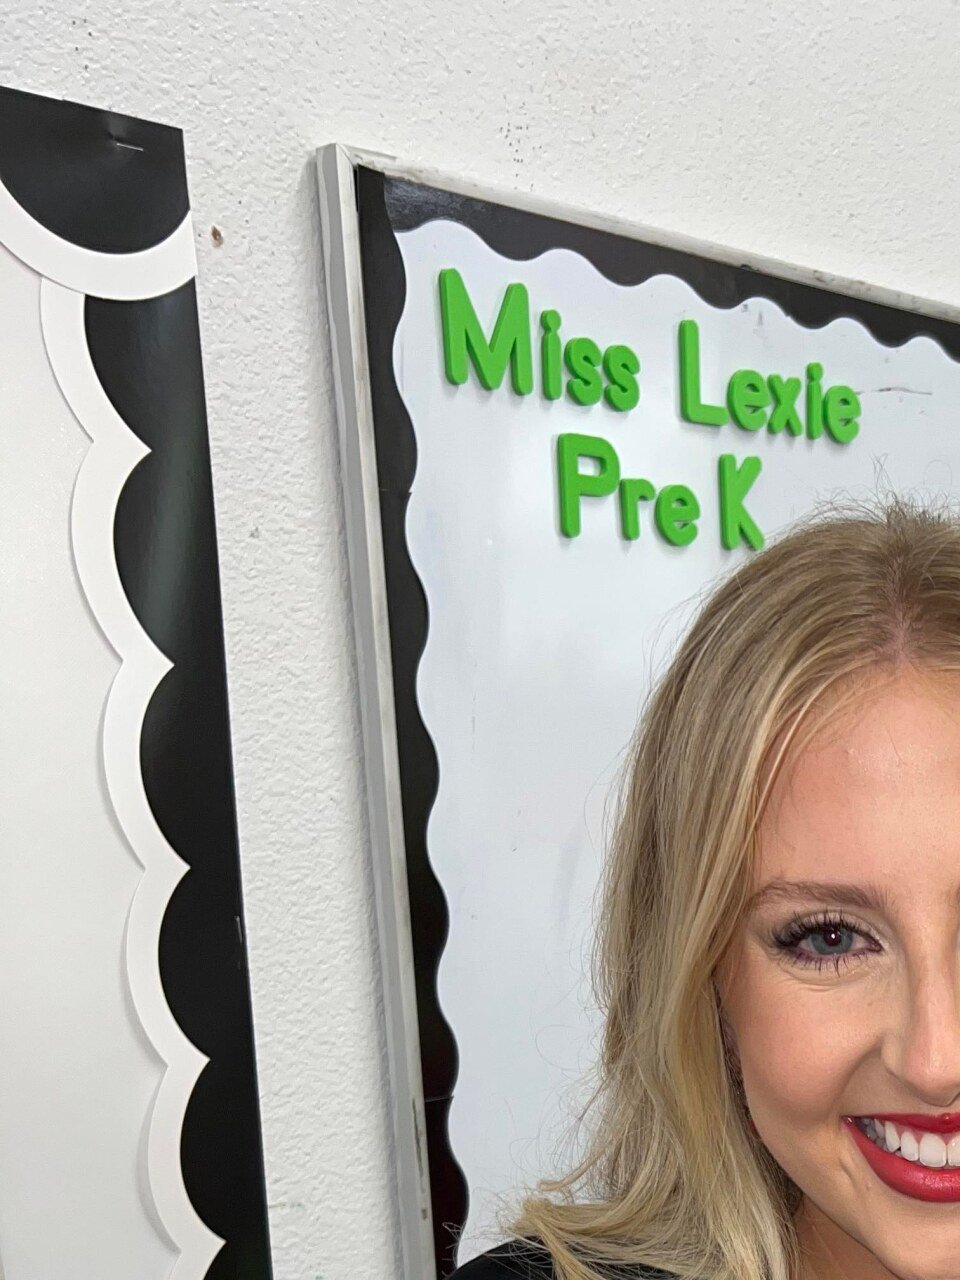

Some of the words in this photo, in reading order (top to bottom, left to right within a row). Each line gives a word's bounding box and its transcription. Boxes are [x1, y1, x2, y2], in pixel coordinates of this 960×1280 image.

[439, 268, 640, 412] Miss
[678, 320, 862, 445] Lexie
[557, 433, 701, 547] Pre
[719, 454, 765, 551] K
